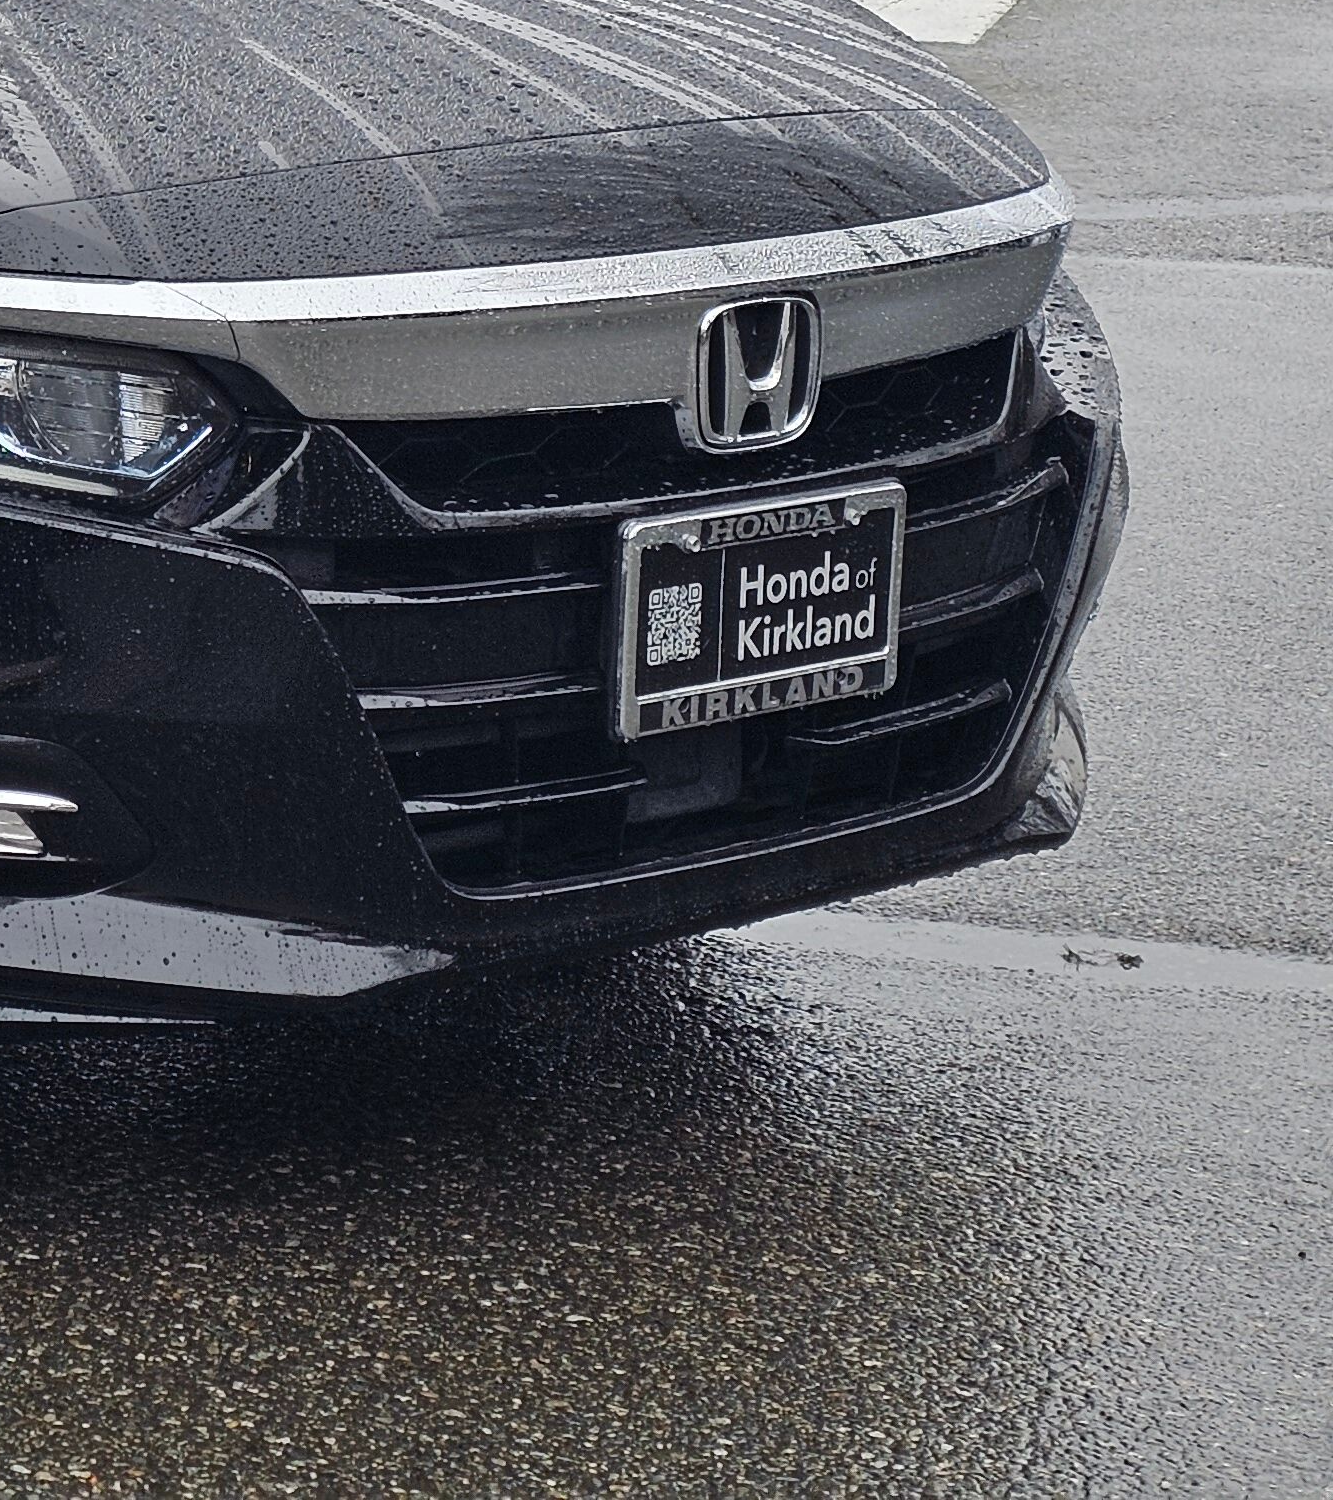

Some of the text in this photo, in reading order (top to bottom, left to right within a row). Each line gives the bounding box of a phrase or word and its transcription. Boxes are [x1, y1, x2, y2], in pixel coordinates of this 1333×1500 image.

[707, 503, 836, 544] HONDA
[738, 550, 878, 609] Honda of
[737, 594, 876, 662] Kirkland
[661, 665, 864, 728] KIRKLAND
